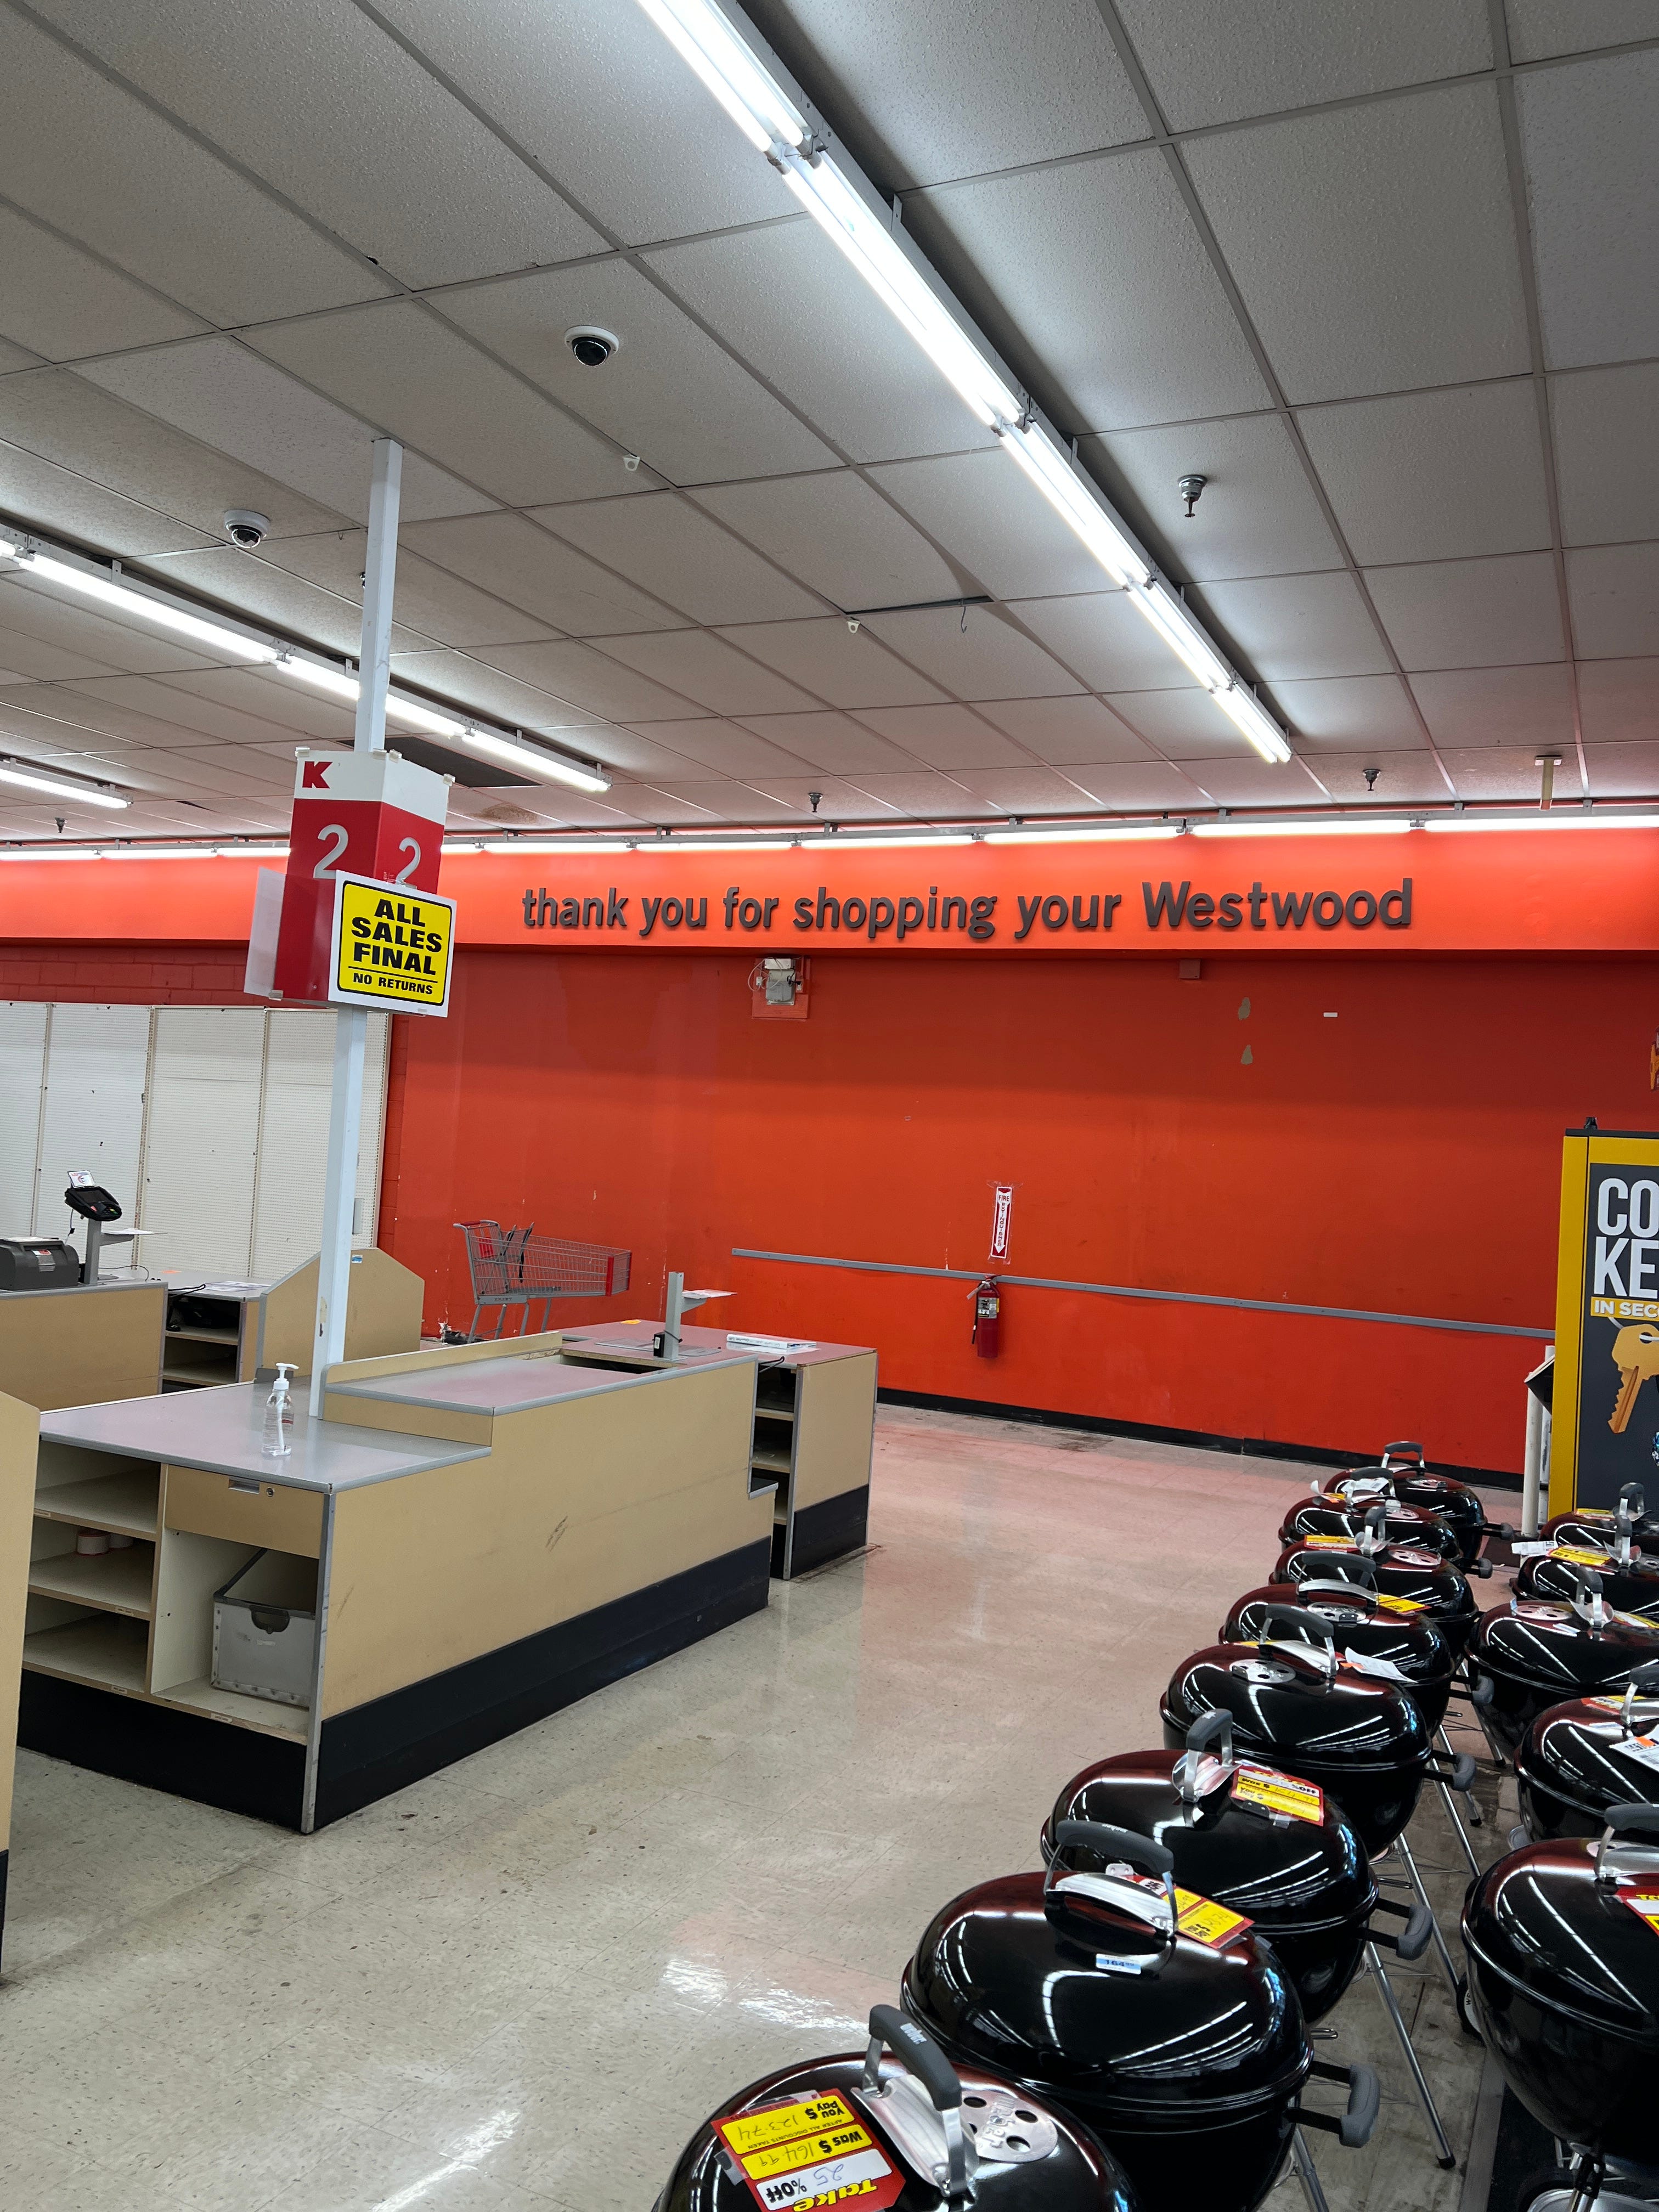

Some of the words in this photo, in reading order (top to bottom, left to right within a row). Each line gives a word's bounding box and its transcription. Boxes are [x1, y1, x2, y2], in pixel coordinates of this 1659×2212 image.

[302, 761, 332, 789] K
[313, 823, 348, 879] 2
[396, 837, 421, 889] 2
[374, 899, 426, 927] ALL
[522, 887, 629, 928] thank
[639, 897, 708, 936] you
[723, 887, 778, 928] for
[793, 885, 997, 939] shopping
[1014, 894, 1121, 939] your
[1142, 878, 1412, 928] Westwood
[351, 917, 442, 953] SALES
[353, 944, 436, 975] FINAL
[353, 972, 372, 985] NO
[378, 977, 433, 995] RETURNS
[1593, 1236, 1659, 1299] KE
[1594, 1300, 1614, 1314] IN
[1619, 1302, 1659, 1318] SEC
[804, 2107, 817, 2121] $
[822, 2108, 845, 2118] You
[822, 2119, 843, 2129] AFTER
[808, 2124, 822, 2132] ALL
[833, 2131, 863, 2147] Was
[748, 2139, 770, 2150] TAKEN
[818, 2140, 833, 2155] $
[813, 2164, 844, 2186] 25
[793, 2179, 877, 2212] Take
